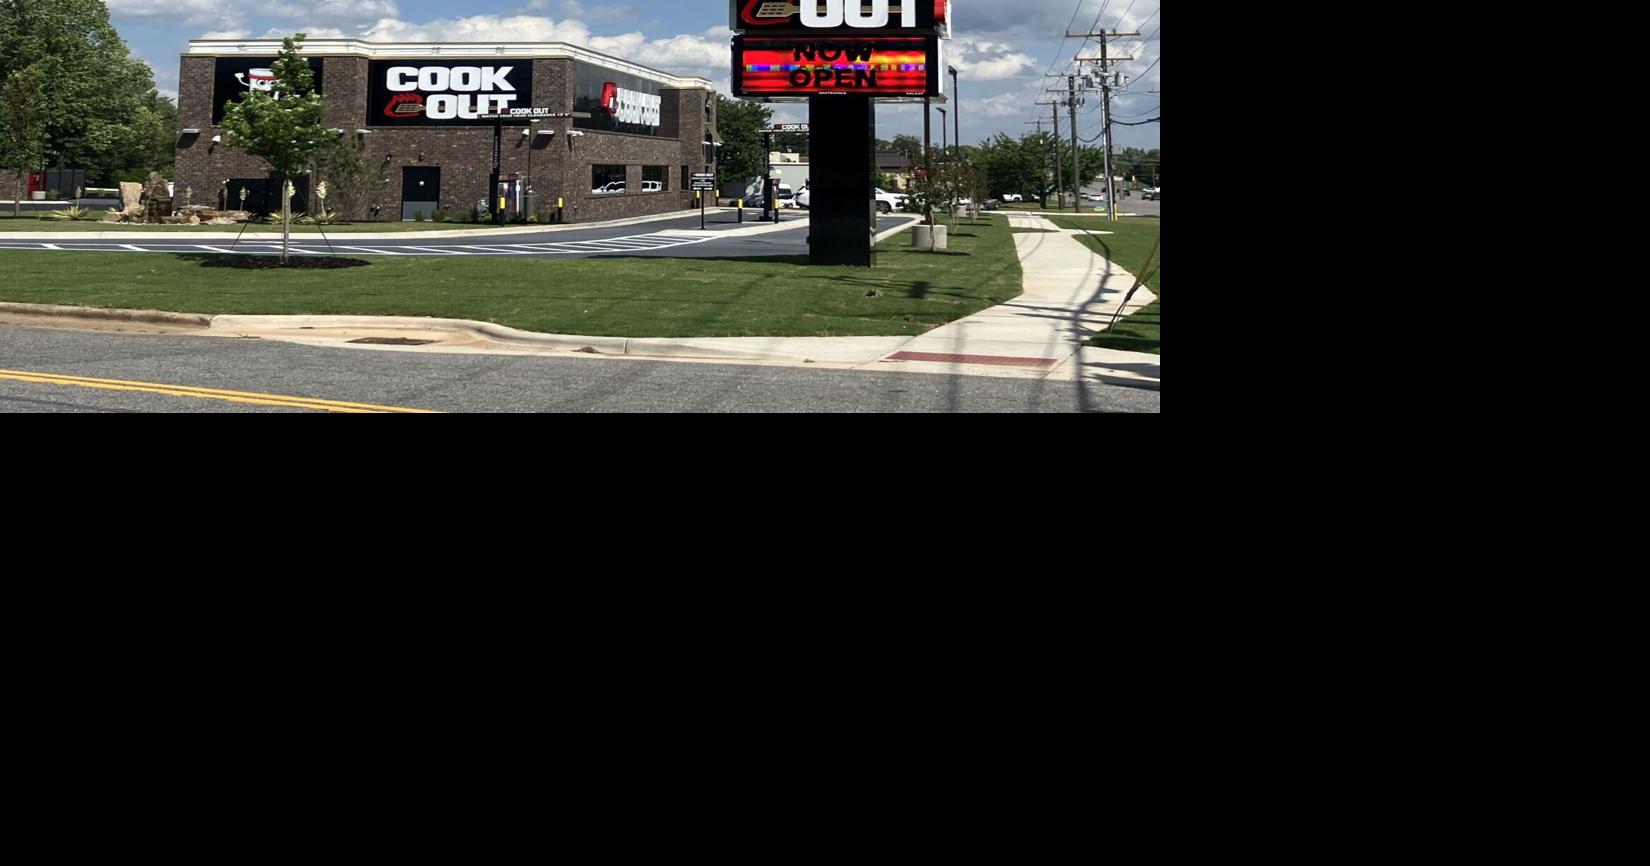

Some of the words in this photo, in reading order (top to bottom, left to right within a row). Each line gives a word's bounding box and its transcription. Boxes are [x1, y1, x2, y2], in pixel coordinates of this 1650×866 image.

[792, 43, 875, 62] NOW
[386, 66, 517, 91] COOK
[788, 68, 878, 88] OPEN
[426, 94, 517, 119] OUT
[510, 107, 532, 115] COOK
